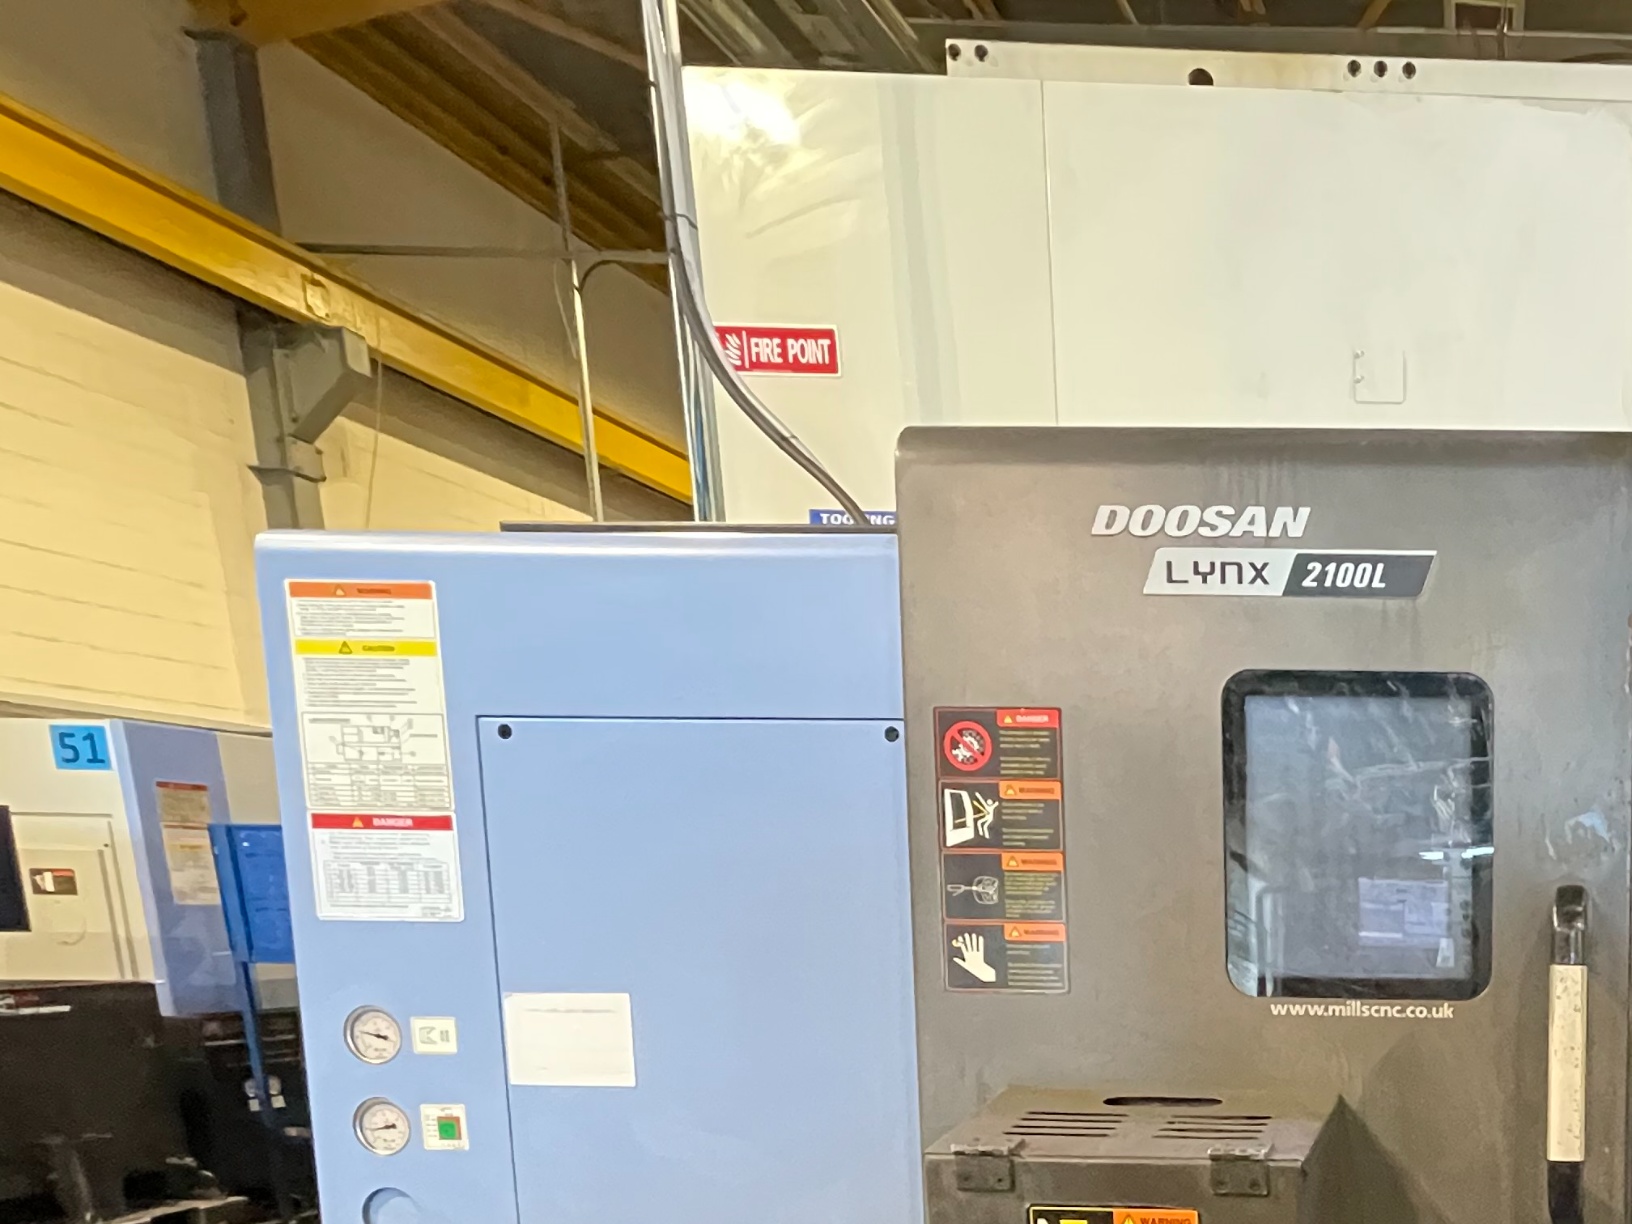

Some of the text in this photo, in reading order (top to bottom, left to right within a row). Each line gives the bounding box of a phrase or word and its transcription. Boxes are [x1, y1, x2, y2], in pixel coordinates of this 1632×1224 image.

[749, 337, 831, 365] FIRE POINT
[819, 512, 896, 525] TOONG
[1091, 504, 1312, 539] DOOSAN
[1301, 561, 1387, 589] 2100L
[57, 731, 106, 765] 51
[1270, 1000, 1455, 1020] www.millscnc.co.uk
